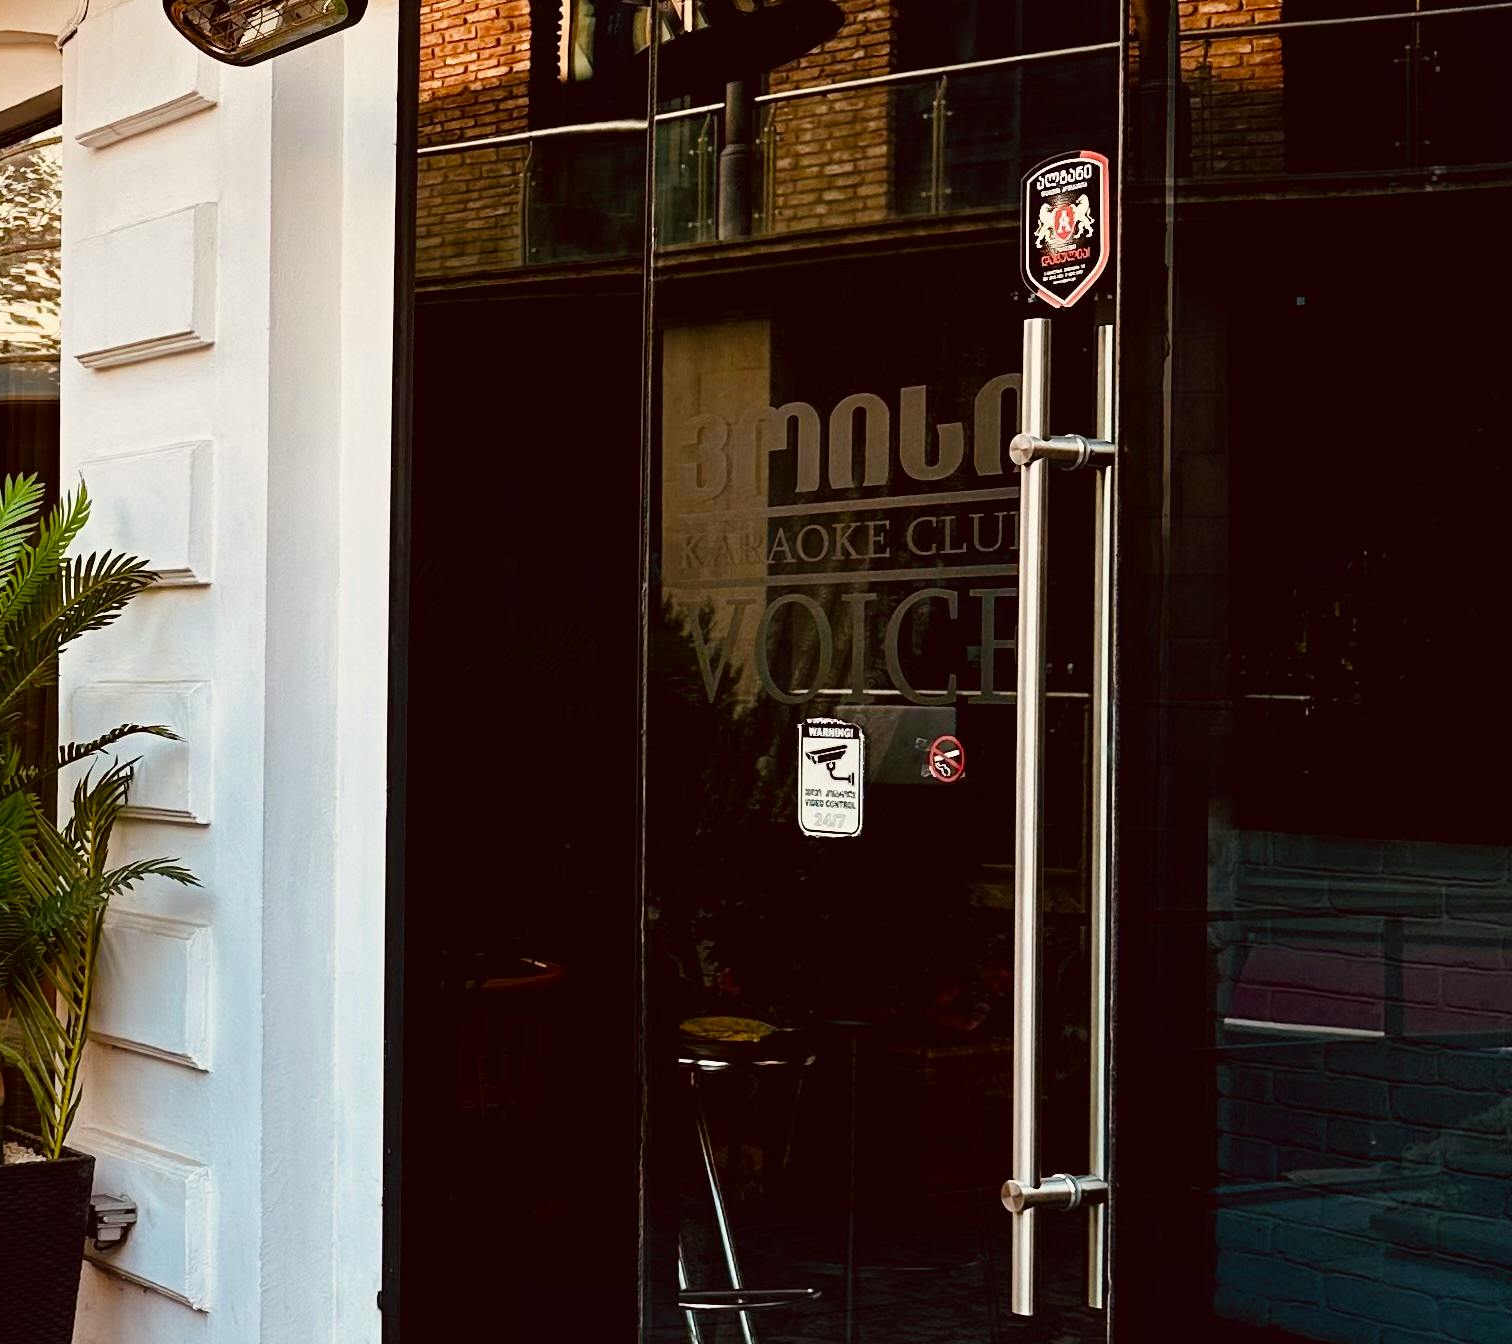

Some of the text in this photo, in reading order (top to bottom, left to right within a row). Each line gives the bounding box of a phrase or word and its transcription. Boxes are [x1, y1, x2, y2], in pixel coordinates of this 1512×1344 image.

[682, 511, 1020, 569] KARAOKE CLU
[681, 588, 1019, 705] VOICE
[808, 726, 854, 738] WARNING!
